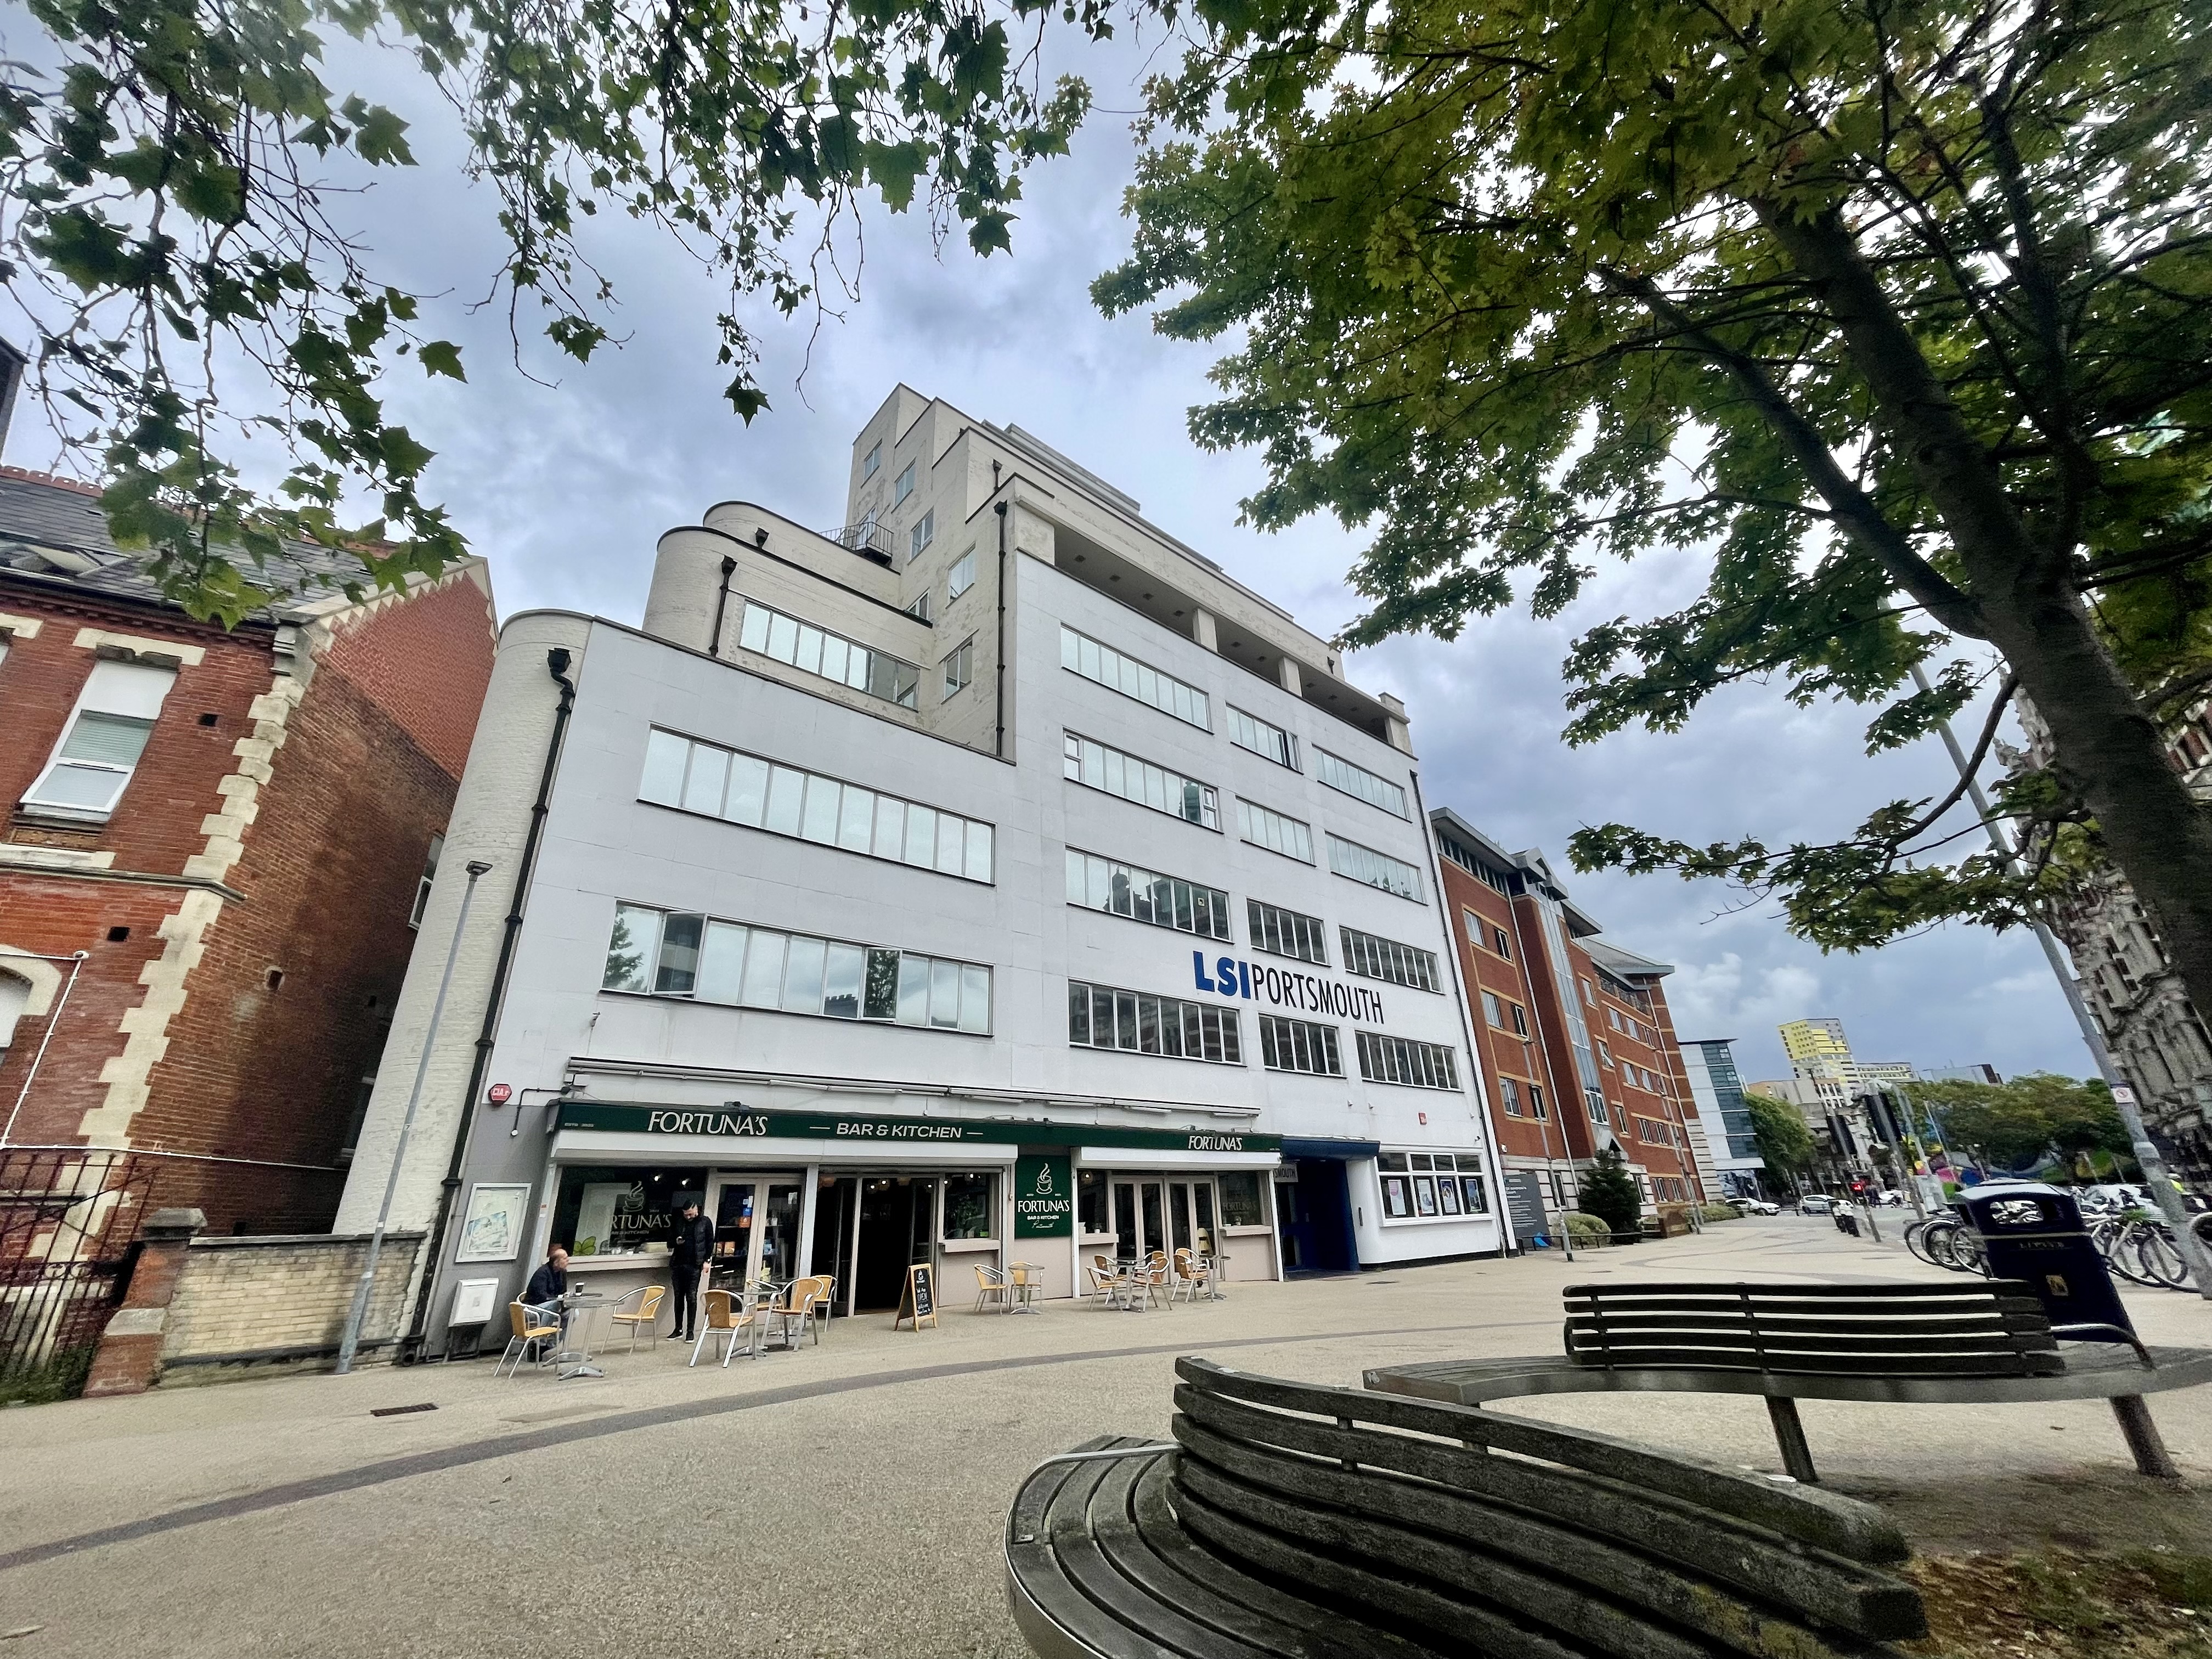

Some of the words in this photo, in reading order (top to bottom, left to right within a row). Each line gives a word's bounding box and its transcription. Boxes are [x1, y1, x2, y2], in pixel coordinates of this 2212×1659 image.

[1193, 950, 1251, 1000] LSI
[1251, 963, 1385, 1024] PORTSMOUTH
[648, 1111, 768, 1136] FORTUNA'S
[836, 1122, 873, 1136] BAR
[876, 1124, 889, 1136] &
[891, 1125, 962, 1138] KITCHEN
[1188, 1135, 1243, 1151] FORTUNA'S
[1273, 1167, 1297, 1178] SMOUTH
[1018, 1199, 1070, 1213] FORTUNA'S
[611, 1214, 672, 1229] RTUNA'S
